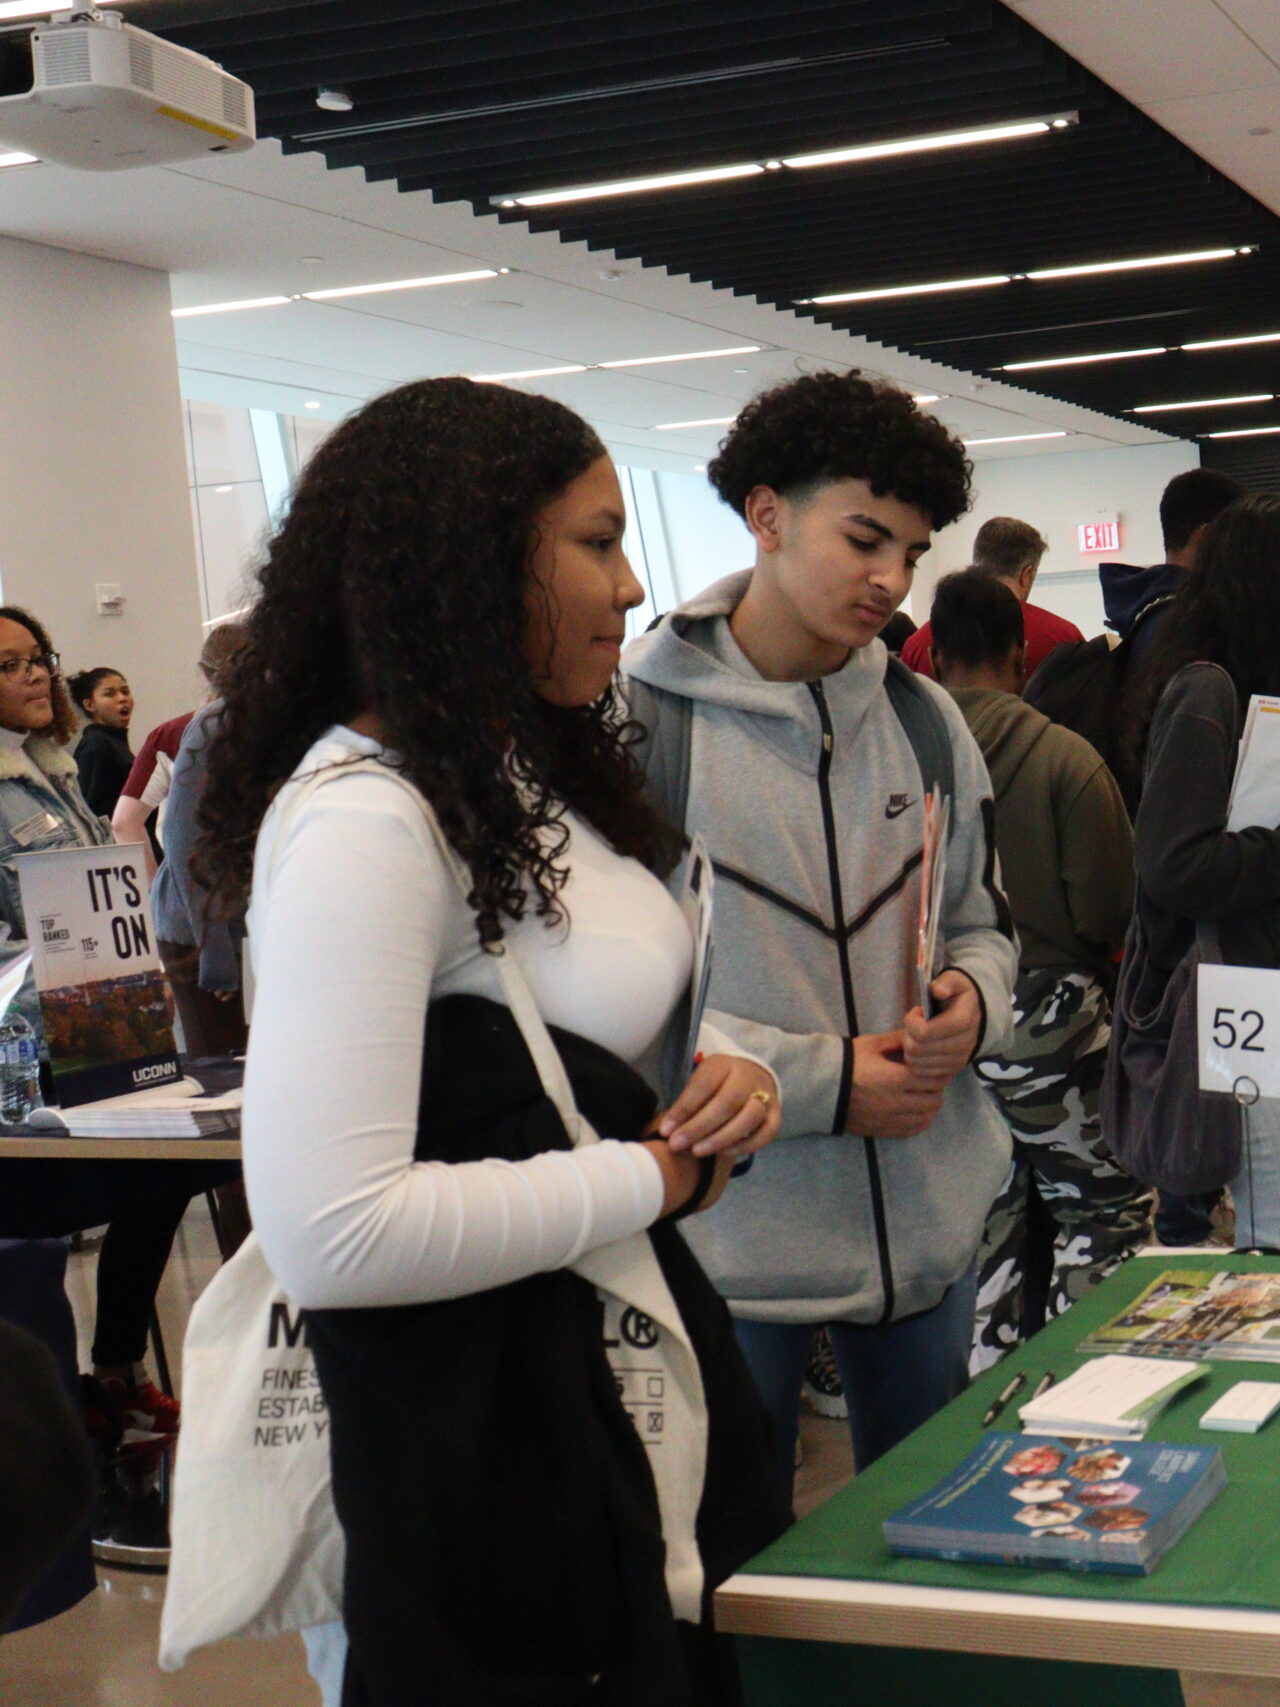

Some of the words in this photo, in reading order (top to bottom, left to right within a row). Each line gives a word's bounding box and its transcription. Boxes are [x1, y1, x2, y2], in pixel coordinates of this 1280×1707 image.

[1084, 523, 1113, 549] EXIT
[87, 865, 141, 912] IT'S
[40, 919, 55, 930] TOP
[111, 913, 150, 960] ON
[1212, 1008, 1265, 1052] 52
[132, 1061, 177, 1082] UCONN
[261, 1368, 321, 1390] FINES
[257, 1394, 326, 1419] ESTAB
[254, 1421, 306, 1447] NEW
[314, 1419, 329, 1439] Y
